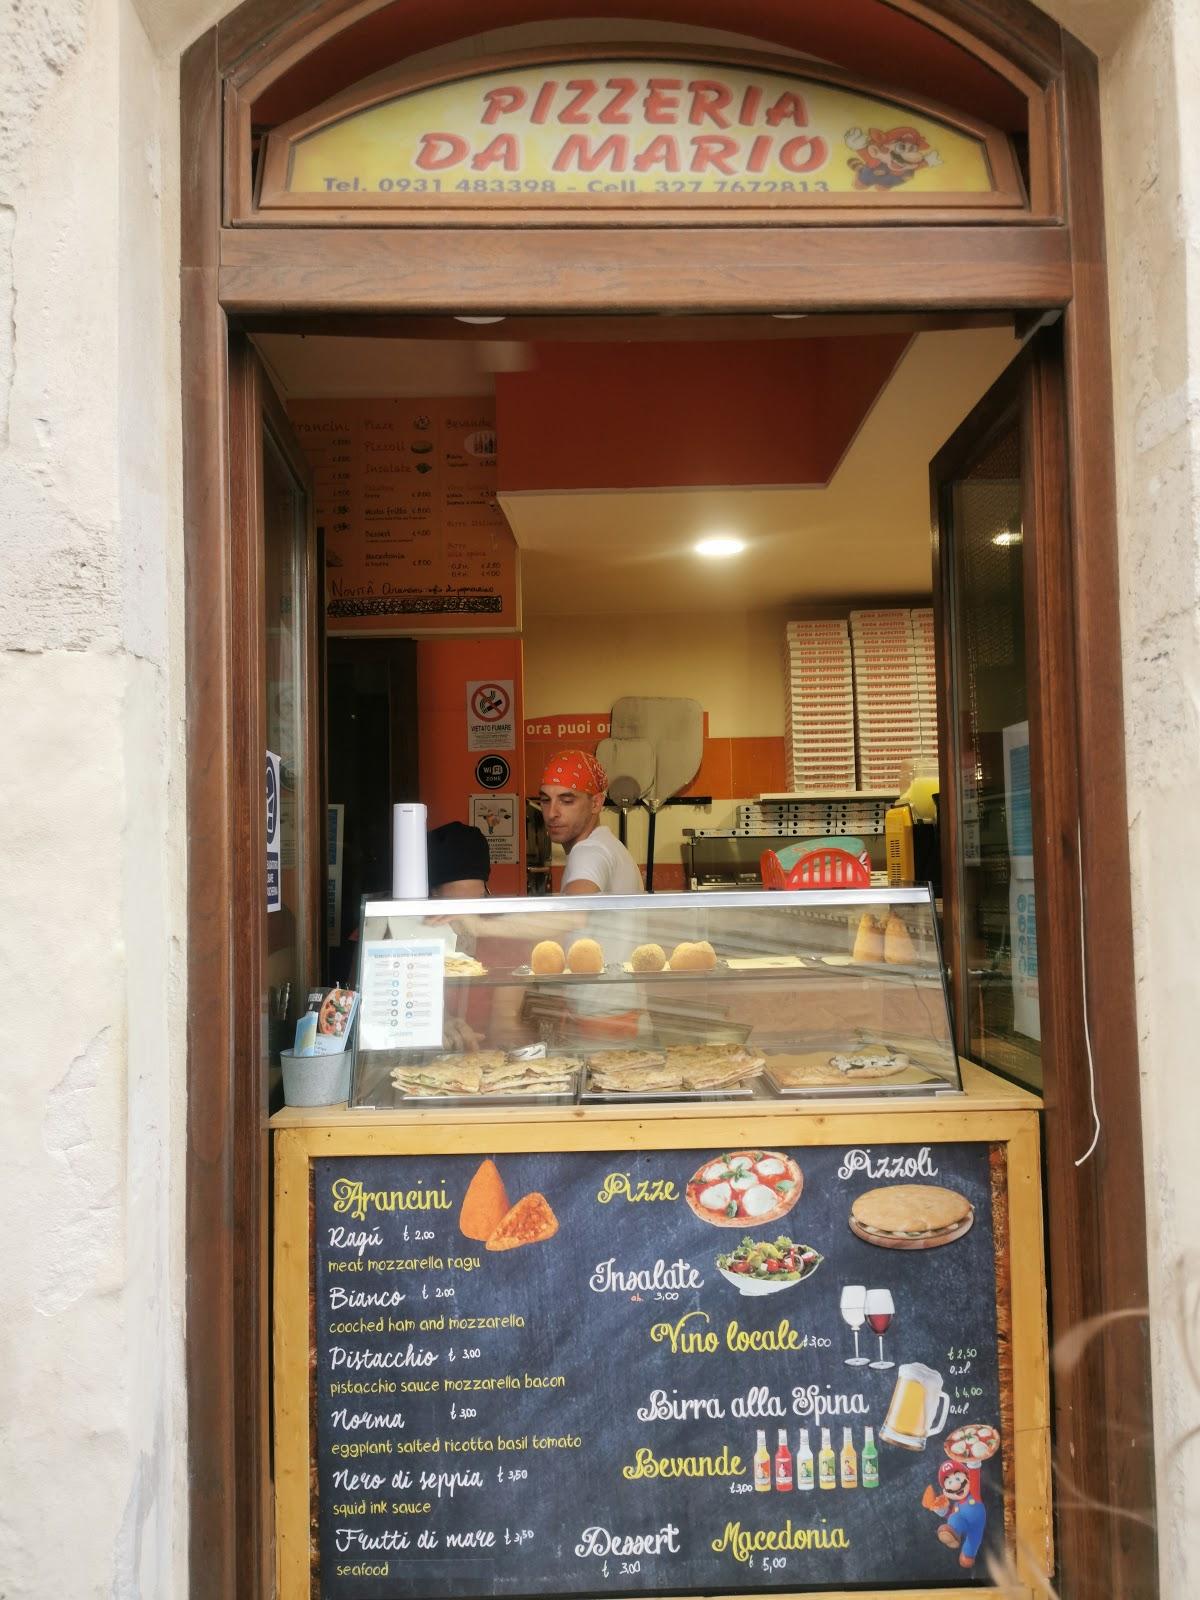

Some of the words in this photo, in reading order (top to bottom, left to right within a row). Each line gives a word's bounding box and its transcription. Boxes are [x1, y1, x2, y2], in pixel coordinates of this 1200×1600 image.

[481, 80, 810, 127] PIZZERIA
[414, 130, 520, 173] DA
[552, 132, 831, 176] MARIO
[323, 176, 367, 192] Tel.
[379, 178, 442, 192] 0931
[455, 179, 555, 192] 483398
[655, 180, 704, 192] 327
[527, 724, 552, 735] ora
[558, 721, 591, 737] puoi
[597, 723, 610, 733] or
[839, 1147, 938, 1180] Pizzoli
[332, 1177, 452, 1221] Arancini
[597, 1172, 679, 1204] Pizze
[328, 1259, 363, 1272] meat
[367, 1256, 443, 1271] mozzarella
[448, 1257, 480, 1272] ragu
[589, 1257, 704, 1294] Insalate
[329, 1287, 406, 1310] Bianco
[653, 1291, 679, 1301] 3,00
[329, 1316, 384, 1333] cooched
[388, 1315, 415, 1332] ham
[420, 1314, 444, 1330] and
[449, 1313, 525, 1329] mozzarella
[650, 1311, 720, 1354] Vino
[726, 1319, 803, 1352] locale
[329, 1344, 438, 1370] Pistacchio
[330, 1377, 396, 1395] pistacchio
[400, 1379, 440, 1392] sauce
[444, 1375, 520, 1391] mozzarella
[525, 1374, 565, 1388] bacon
[637, 1389, 725, 1423] Birra
[730, 1386, 787, 1418] alla
[791, 1385, 869, 1426] Spina
[331, 1409, 405, 1431] Norma
[331, 1440, 392, 1458] eggplant
[397, 1436, 440, 1453] salted
[445, 1437, 493, 1452] ricotta
[497, 1435, 528, 1451] basil
[533, 1433, 582, 1449] tomato
[623, 1446, 746, 1480] Bevande
[333, 1469, 385, 1491] Nero
[391, 1467, 413, 1490] di
[419, 1468, 483, 1497] seppia
[333, 1500, 366, 1516] squid
[370, 1498, 388, 1514] ink
[392, 1500, 432, 1514] sauce
[335, 1528, 410, 1553] Frutti
[417, 1528, 439, 1549] di
[446, 1531, 496, 1548] mare
[575, 1523, 680, 1558] Dessert
[712, 1518, 850, 1562] Macedonia
[336, 1562, 389, 1577] seafood
